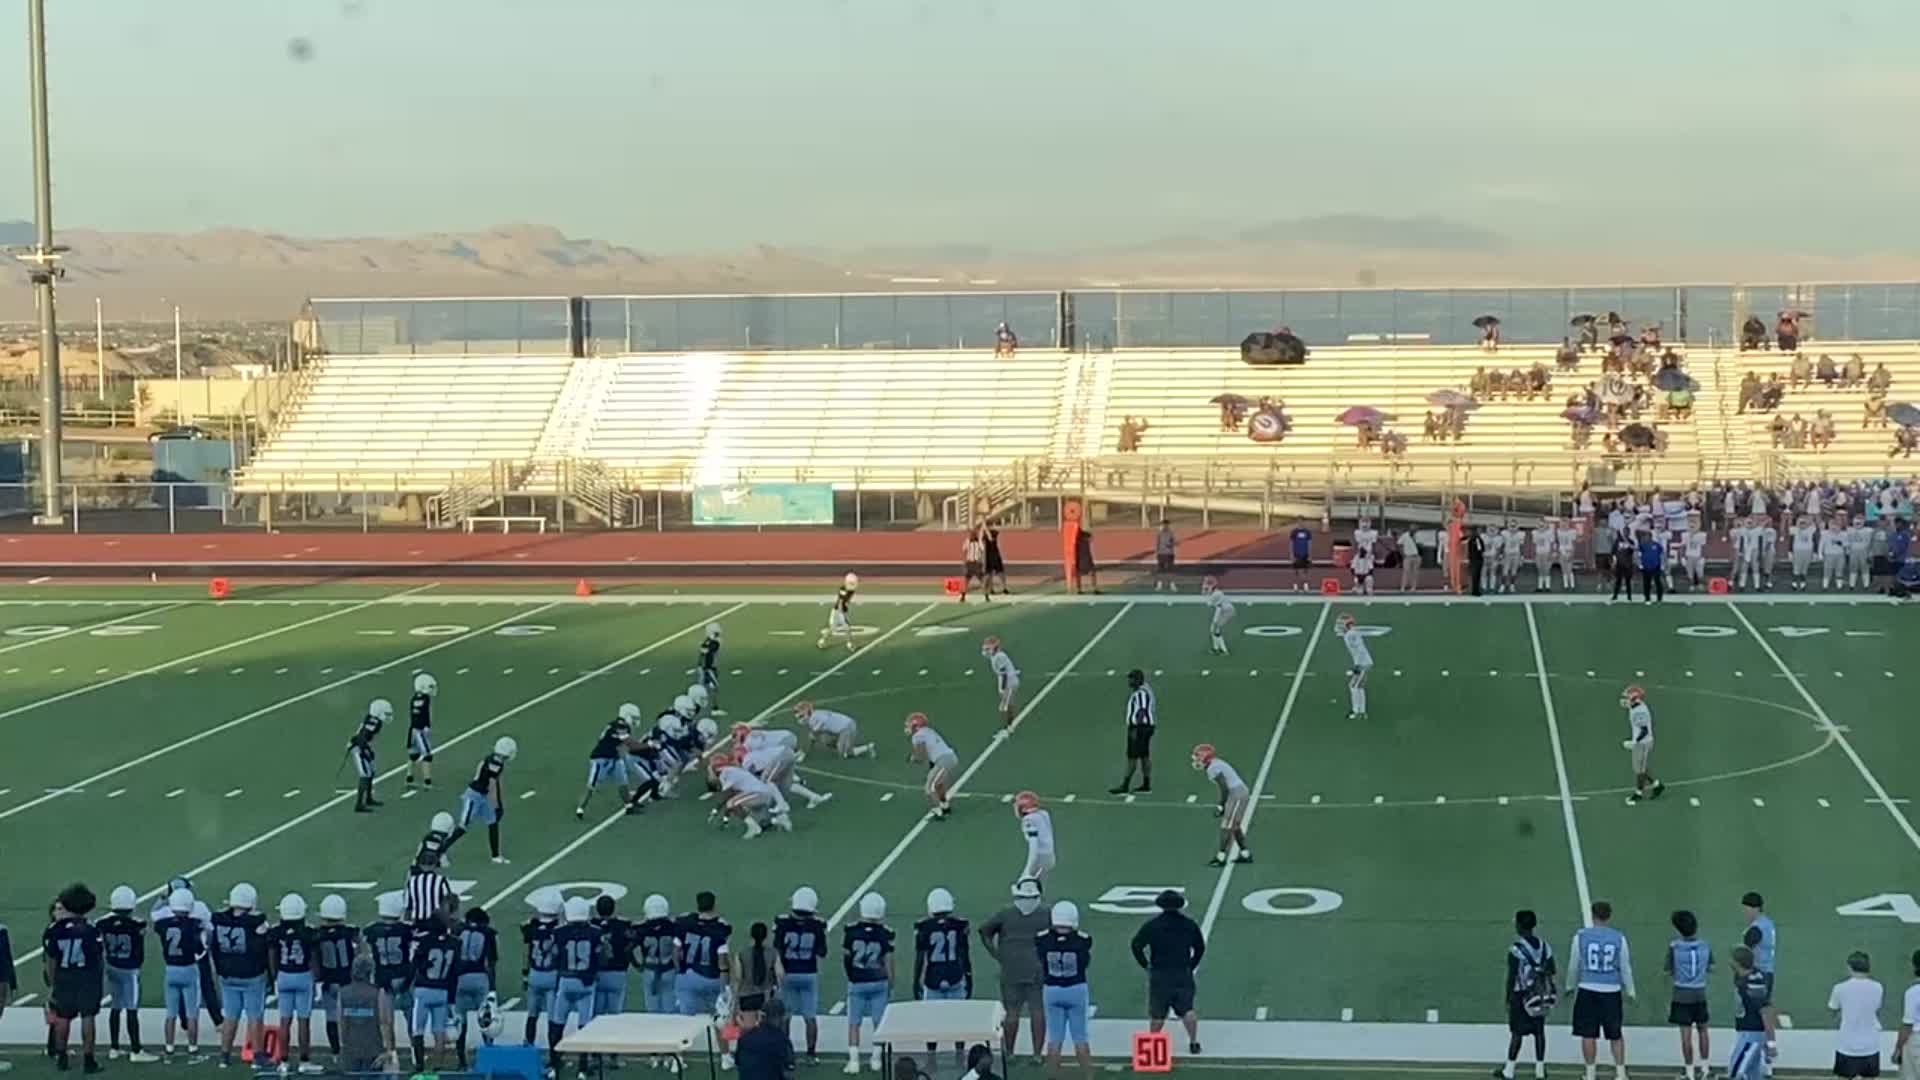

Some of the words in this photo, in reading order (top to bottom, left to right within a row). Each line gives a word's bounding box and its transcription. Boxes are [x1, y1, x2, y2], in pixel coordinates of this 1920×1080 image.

[166, 926, 184, 956] 2
[685, 932, 711, 966] 71
[930, 930, 957, 963] 21
[1587, 942, 1616, 972] 62
[1137, 1037, 1167, 1067] 50
